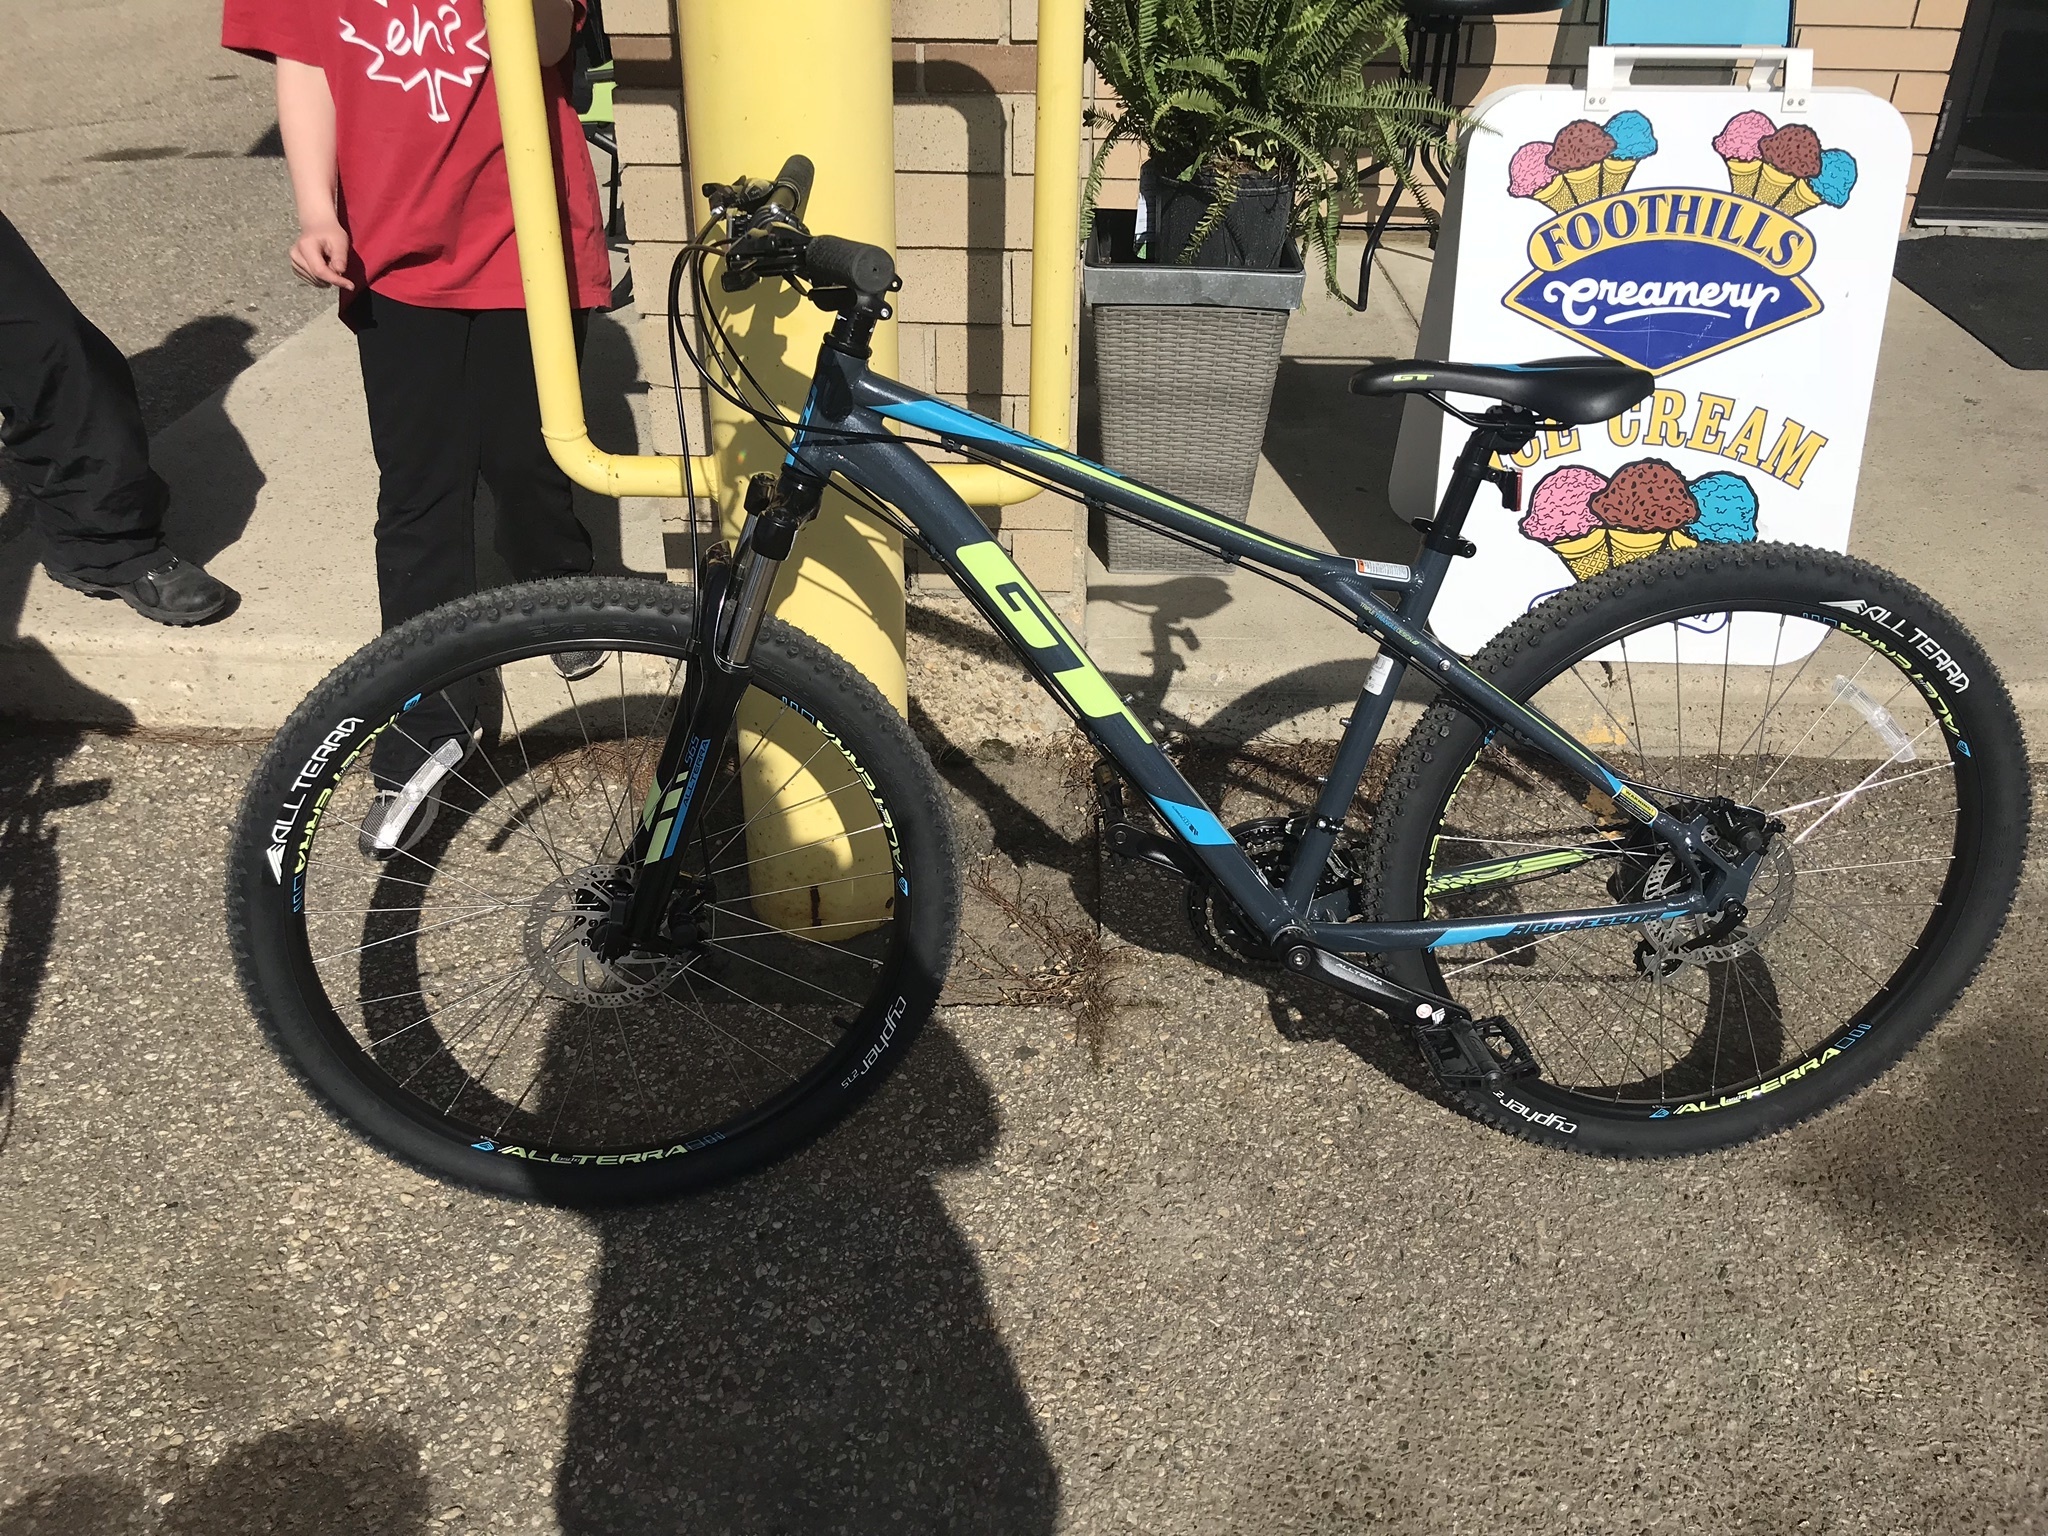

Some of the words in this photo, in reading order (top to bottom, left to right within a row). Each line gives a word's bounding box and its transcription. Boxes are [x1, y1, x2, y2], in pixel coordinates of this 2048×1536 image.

[385, 4, 462, 56] eh?
[1539, 194, 1805, 269] FOOTHILLS
[1543, 277, 1781, 330] Creamery
[1393, 374, 1435, 382] GT
[1607, 388, 1829, 490] CREAM
[956, 540, 1153, 744] GT
[1860, 605, 1907, 638] ALL
[1908, 627, 1970, 694] TERRA
[271, 793, 307, 844] ALL
[290, 716, 365, 792] TERRA
[860, 995, 907, 1075] cypher
[1499, 1098, 1578, 1135] cypher
